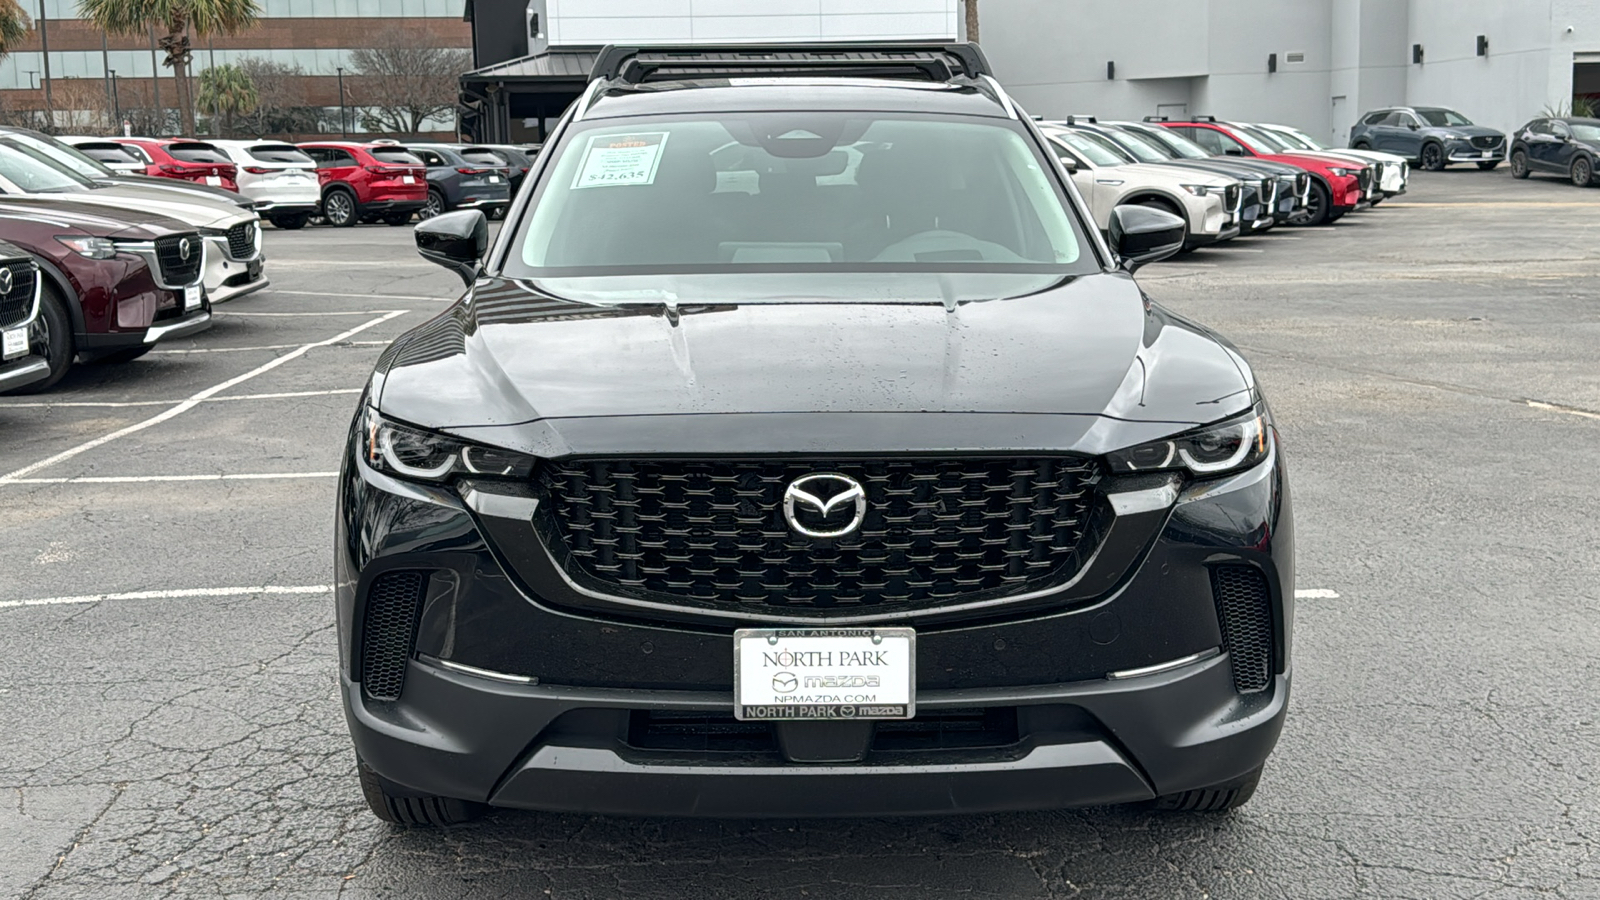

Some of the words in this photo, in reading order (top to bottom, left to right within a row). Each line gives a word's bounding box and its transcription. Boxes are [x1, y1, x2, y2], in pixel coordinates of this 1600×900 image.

[778, 629, 806, 637] SAN
[810, 629, 872, 637] ANTONIO
[762, 650, 832, 668] NORTH
[839, 650, 889, 667] PARK
[804, 675, 881, 689] mazda
[774, 694, 877, 703] NPMAZDACOM
[746, 706, 795, 718] NORTH
[800, 705, 837, 718] PARK
[858, 705, 904, 716] mazda
